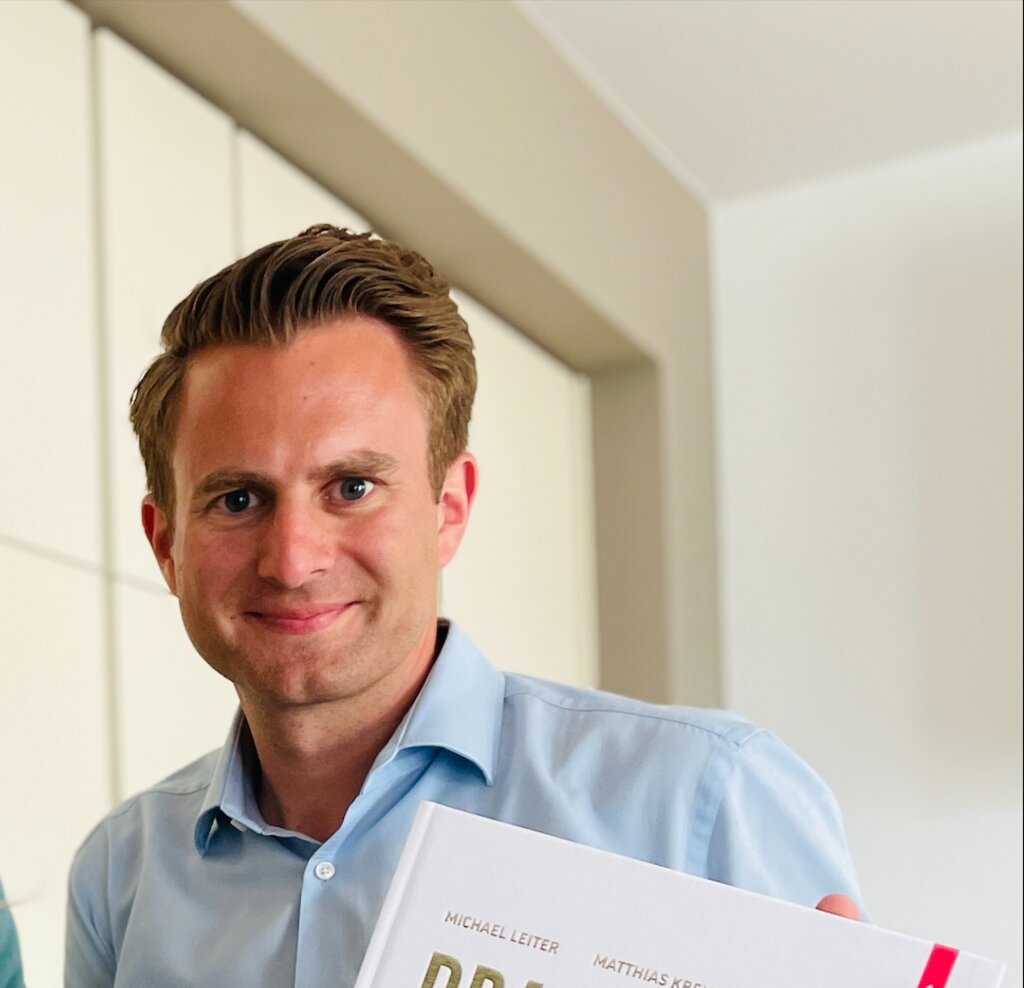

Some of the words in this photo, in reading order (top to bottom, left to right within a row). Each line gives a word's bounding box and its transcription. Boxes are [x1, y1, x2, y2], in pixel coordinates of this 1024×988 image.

[444, 910, 506, 939] MICHAEL
[510, 929, 560, 955] LEITER
[592, 953, 669, 987] MATTHIAS
